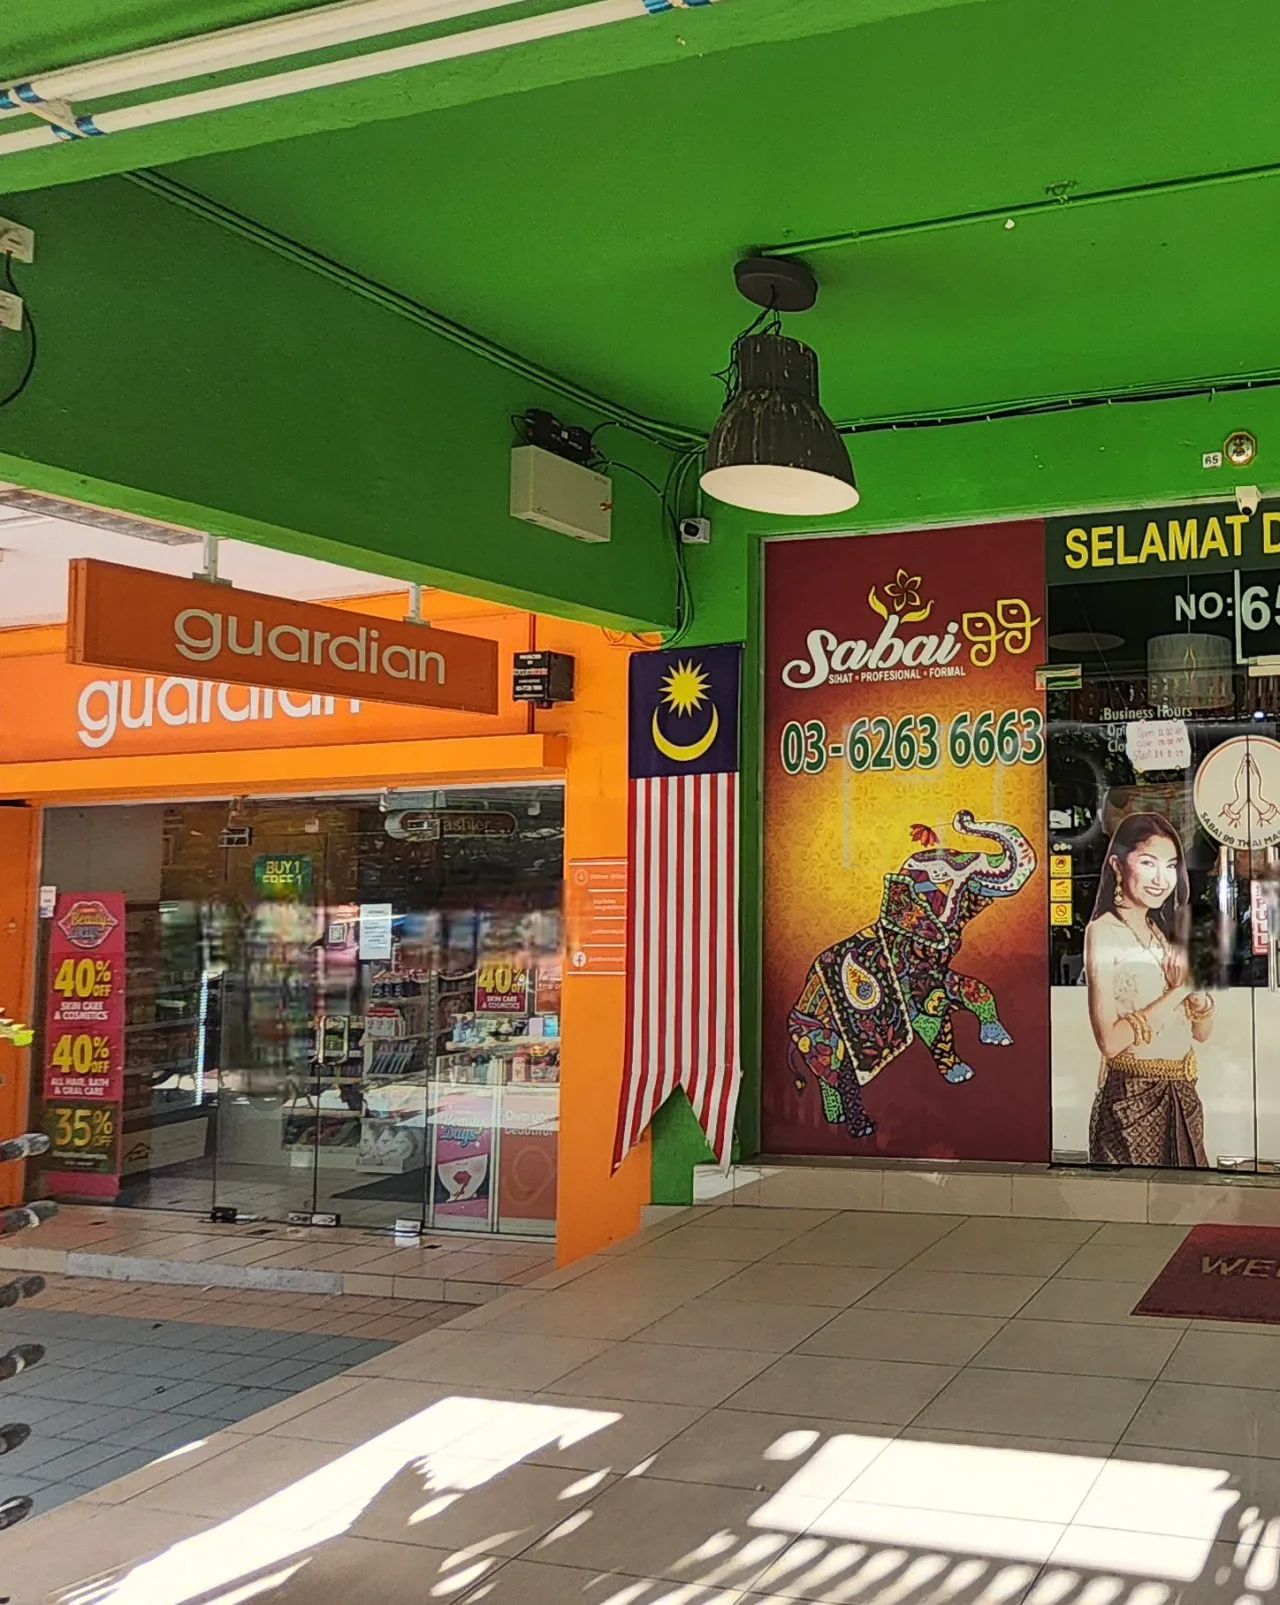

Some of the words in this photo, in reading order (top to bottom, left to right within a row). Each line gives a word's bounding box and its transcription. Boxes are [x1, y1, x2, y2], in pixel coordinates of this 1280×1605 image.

[1204, 454, 1219, 465] 65
[1065, 514, 1250, 569] SELAMAT
[174, 608, 445, 685] guardian
[782, 614, 962, 689] Sabai
[828, 672, 853, 685] SIHAT
[860, 669, 922, 682] PROFESIONAL
[929, 666, 966, 678] FORMAL
[1103, 707, 1153, 720] Business
[1157, 704, 1192, 718] Hours
[781, 714, 939, 775] 03-6263
[949, 707, 1045, 767] 6663
[442, 814, 491, 832] ashier
[1200, 811, 1223, 838] SABAI
[1237, 838, 1262, 848] THAI
[266, 860, 292, 874] BUY
[294, 860, 300, 873] 1
[93, 984, 112, 997] OFF
[92, 1060, 110, 1073] OFF
[441, 1124, 476, 1148] Days
